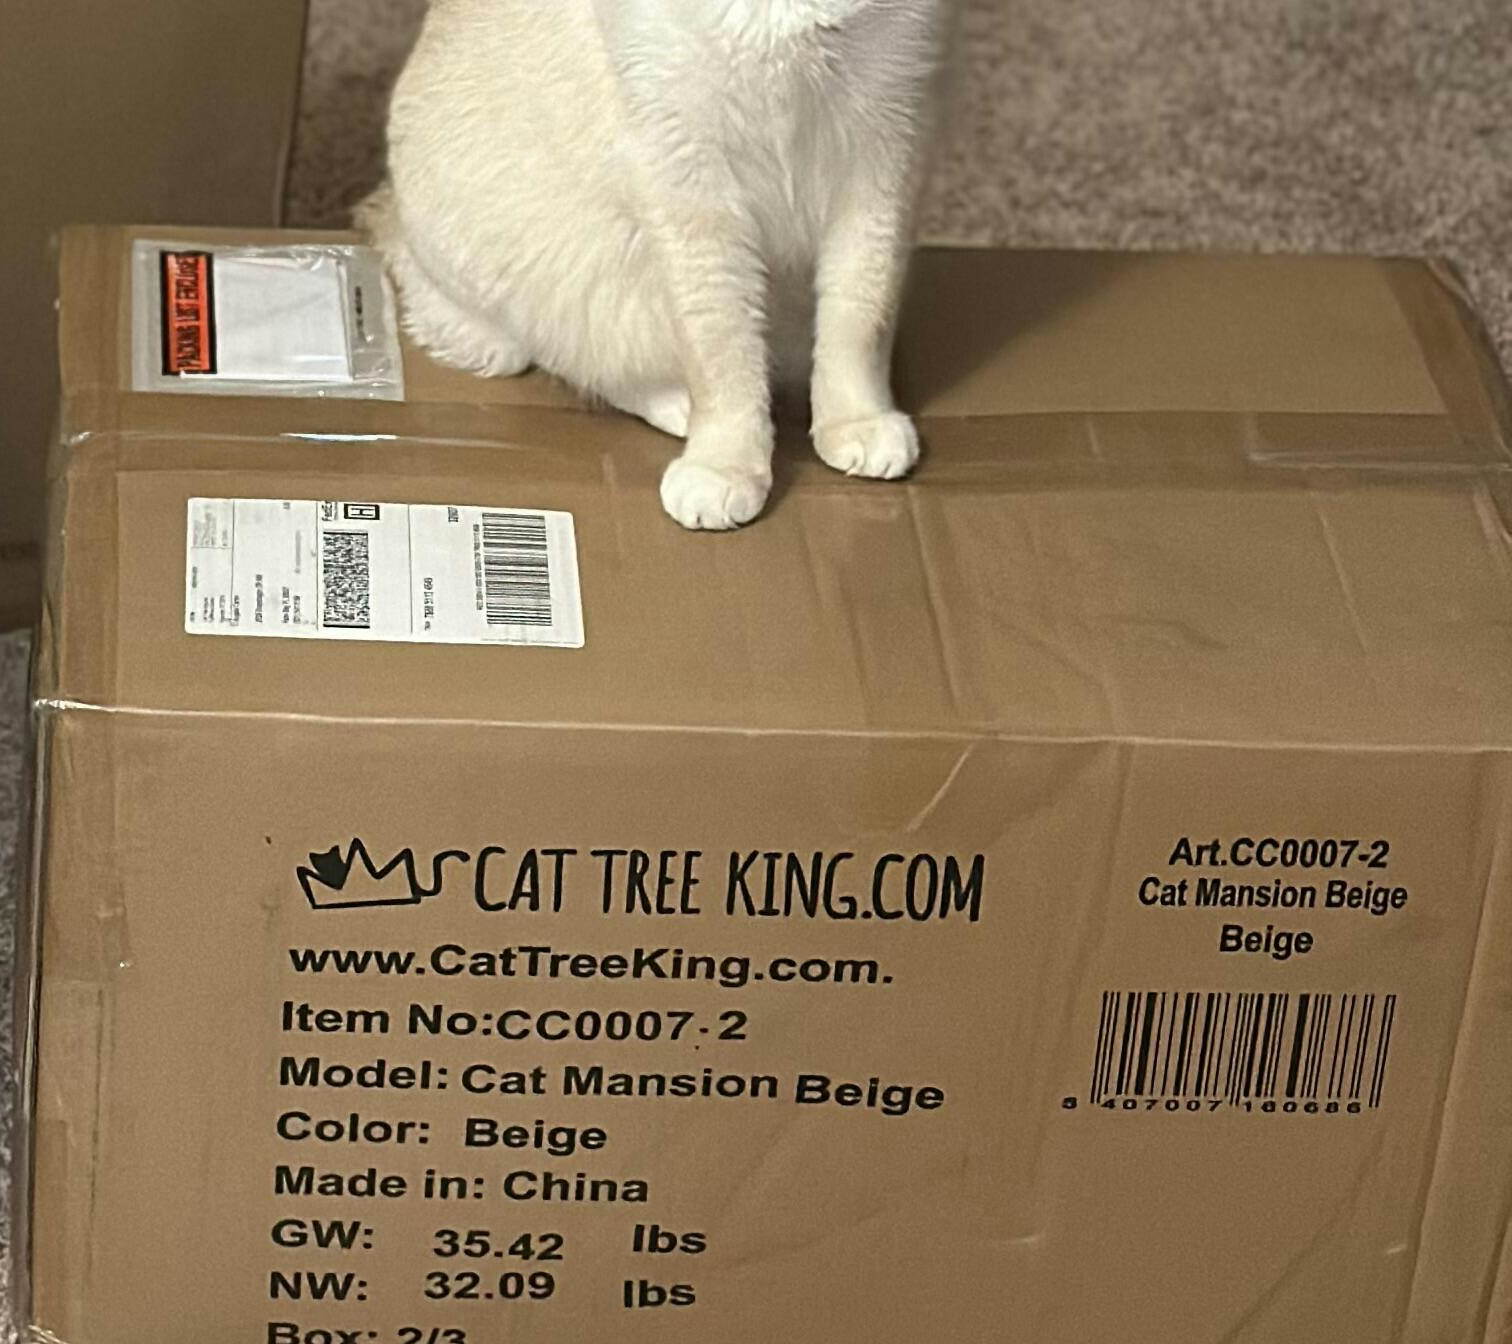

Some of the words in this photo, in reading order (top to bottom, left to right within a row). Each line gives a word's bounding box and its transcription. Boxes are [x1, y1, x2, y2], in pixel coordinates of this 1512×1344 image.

[1168, 837, 1390, 869] Art.CC0007-2
[474, 846, 578, 913] CAT
[590, 849, 703, 916] TREE
[726, 849, 985, 923] KING.COM
[1138, 876, 1189, 907] Cat
[1195, 877, 1317, 909] Mansion
[1324, 879, 1408, 916] Beige
[1219, 924, 1314, 961] Beige
[288, 943, 894, 988] www.CatTreeKing.com.
[282, 1000, 390, 1034] Item
[279, 1056, 448, 1090] Model:
[461, 1064, 547, 1095] Cat
[563, 1065, 779, 1099] Mansion
[794, 1074, 945, 1116] Beige
[1100, 1097, 1224, 1112] 407007
[276, 1111, 430, 1145] Color:
[464, 1117, 608, 1157] Beige
[274, 1165, 408, 1198] Made
[424, 1168, 485, 1200] in:
[503, 1170, 649, 1203] China
[271, 1218, 374, 1250] GW:
[433, 1229, 564, 1261] 35.42
[632, 1224, 707, 1255] lbs
[269, 1271, 368, 1302] NW:
[424, 1271, 556, 1300] 32.09
[623, 1279, 696, 1309] lbs
